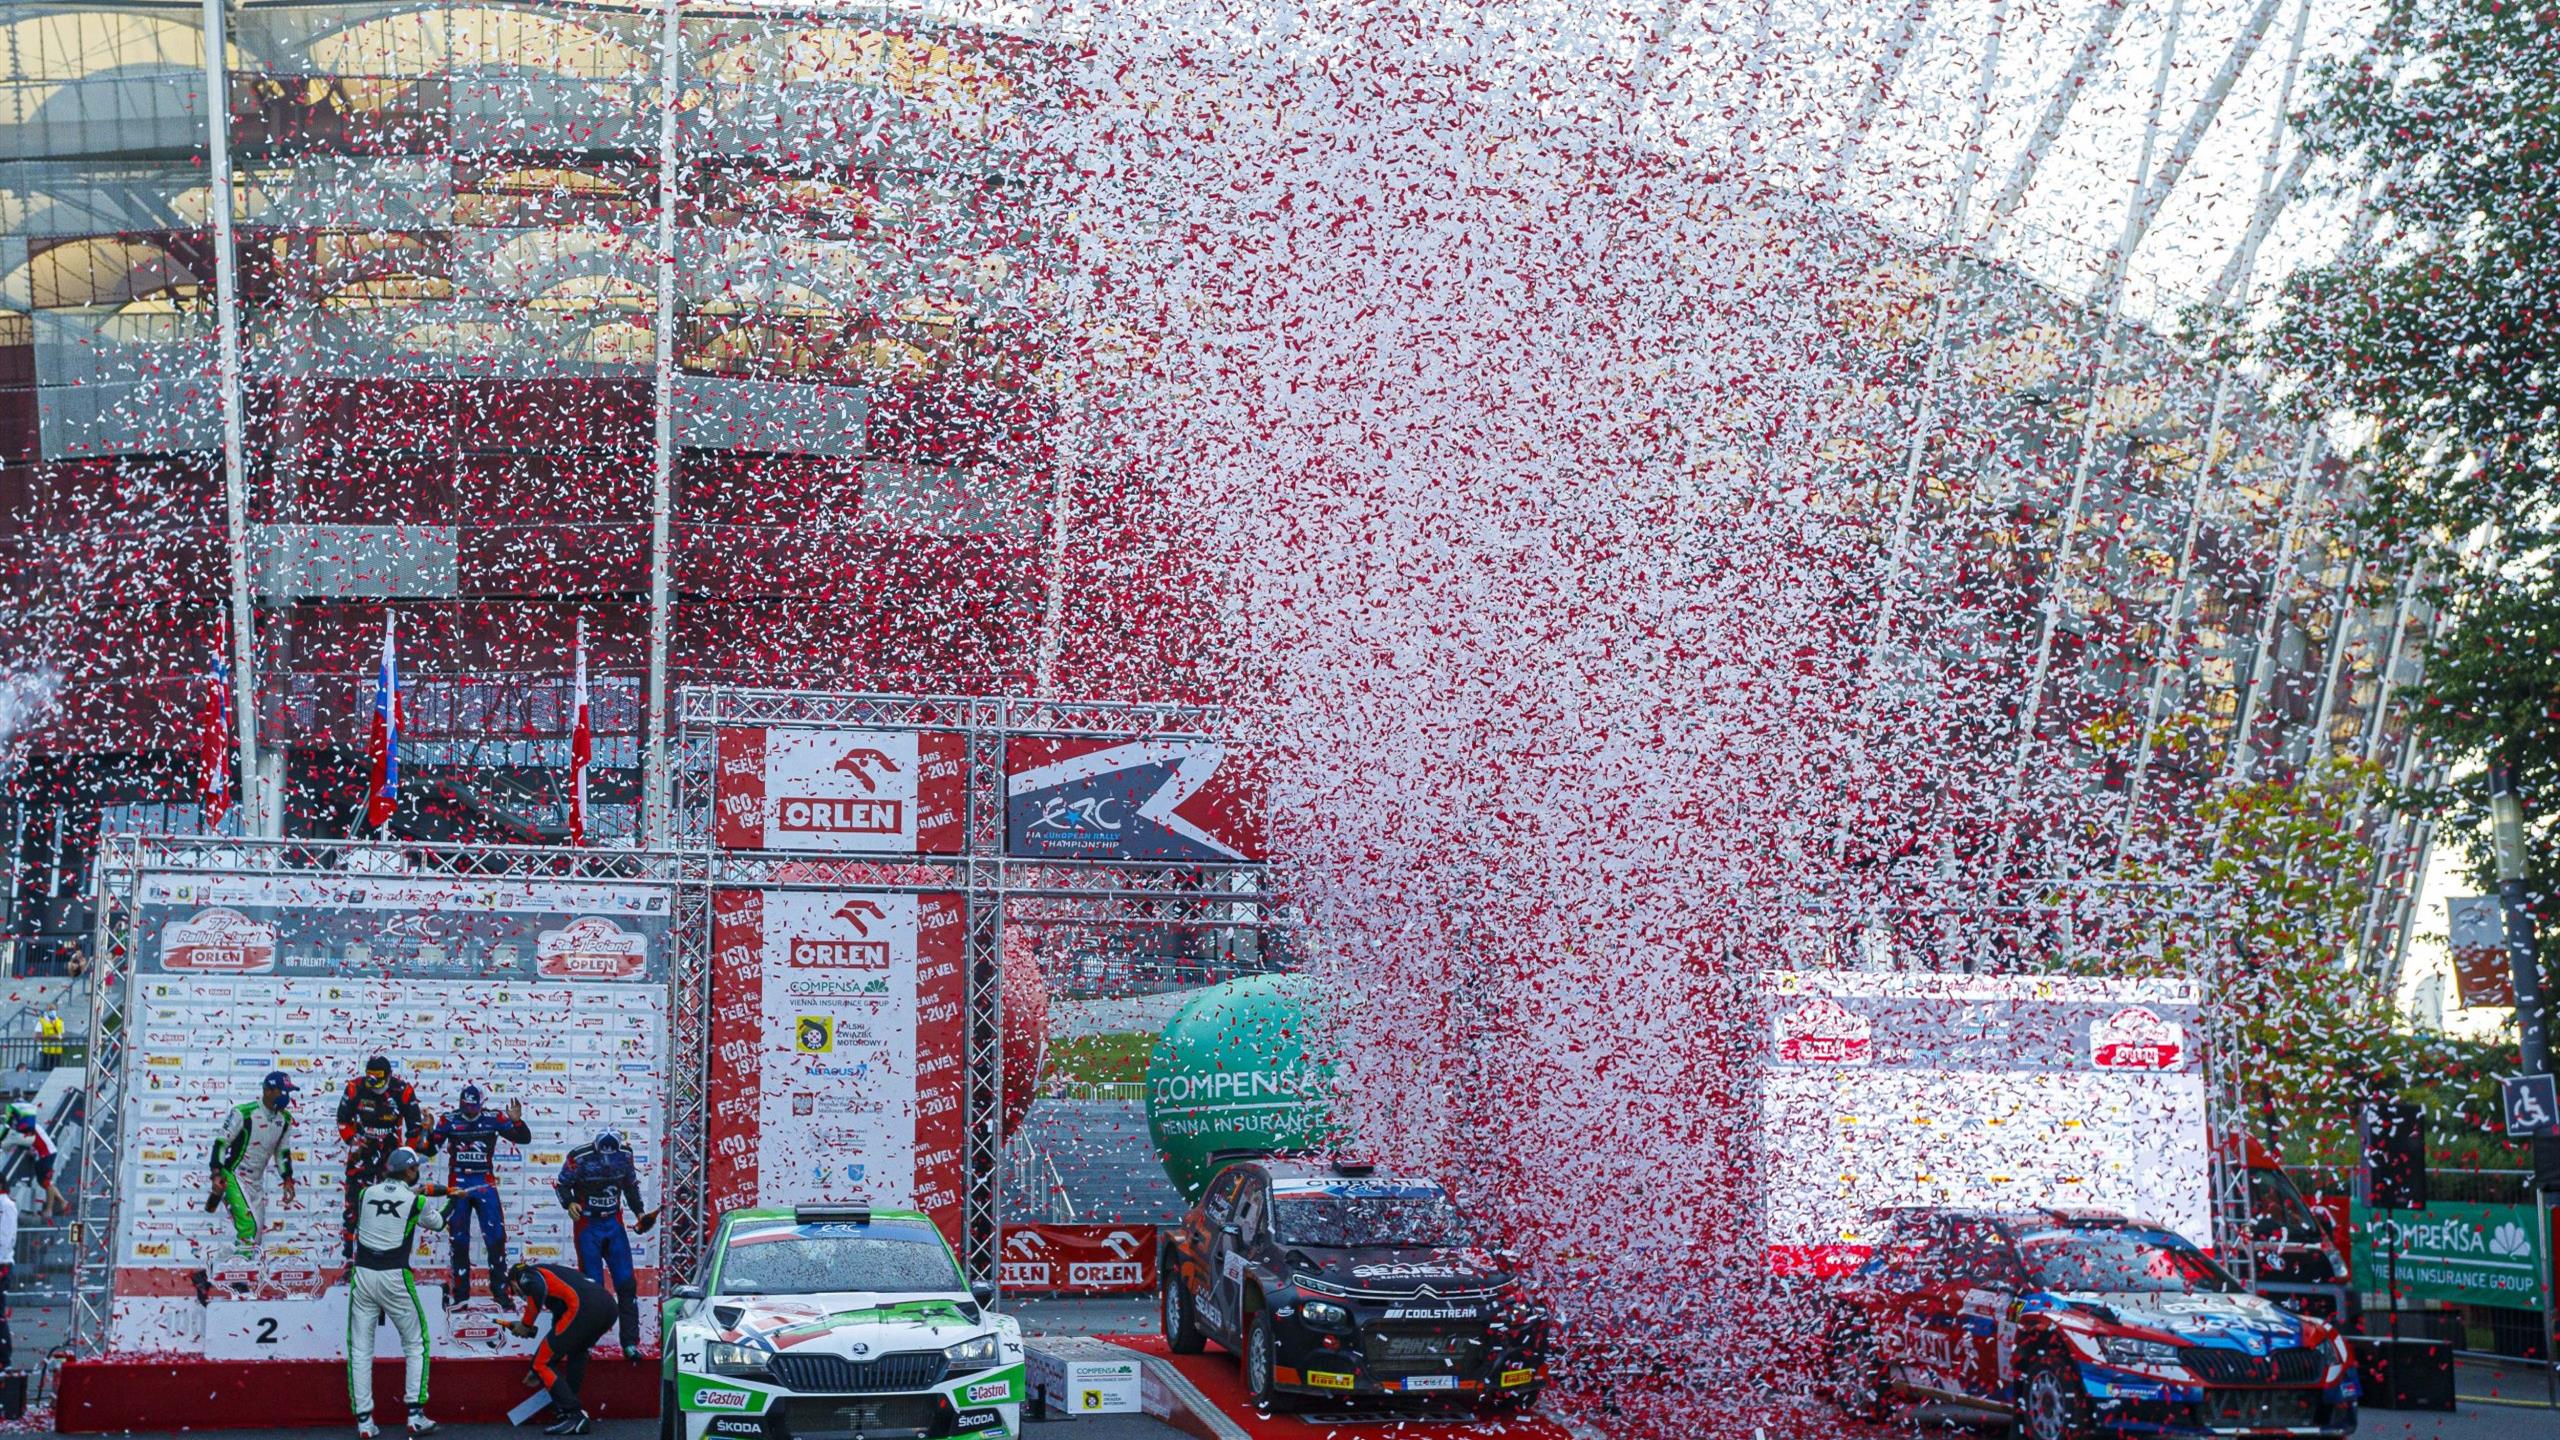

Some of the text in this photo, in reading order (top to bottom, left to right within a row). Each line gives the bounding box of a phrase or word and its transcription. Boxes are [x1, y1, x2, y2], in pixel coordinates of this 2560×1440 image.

[785, 801, 894, 828] ORLEN
[1041, 840, 1120, 848] CHAMPIONSHIP
[209, 917, 233, 930] 77
[177, 931, 213, 946] Rally
[194, 951, 241, 964] ORLEN
[795, 944, 884, 965] ORLEN
[790, 981, 861, 992] COMPENSA
[790, 999, 818, 1007] VIENNA
[820, 999, 861, 1007] INSURANCE
[1157, 1070, 1316, 1101] COMPENSA
[1215, 1113, 1326, 1133] INSURANCE
[2373, 1220, 2485, 1253] COMPENSA
[1074, 1266, 1137, 1282] ORLEN
[2416, 1268, 2487, 1288] INSURANCE
[2489, 1274, 2534, 1292] GROUP
[1405, 1308, 1477, 1319] COOLSTREAM
[256, 1316, 279, 1344] 2
[1077, 1366, 1118, 1375] COMPENSA
[708, 1391, 745, 1406] Castrol
[977, 1383, 1008, 1399] Castrol
[717, 1420, 762, 1433] ŠKODA
[958, 1413, 995, 1428] ŠKODA
